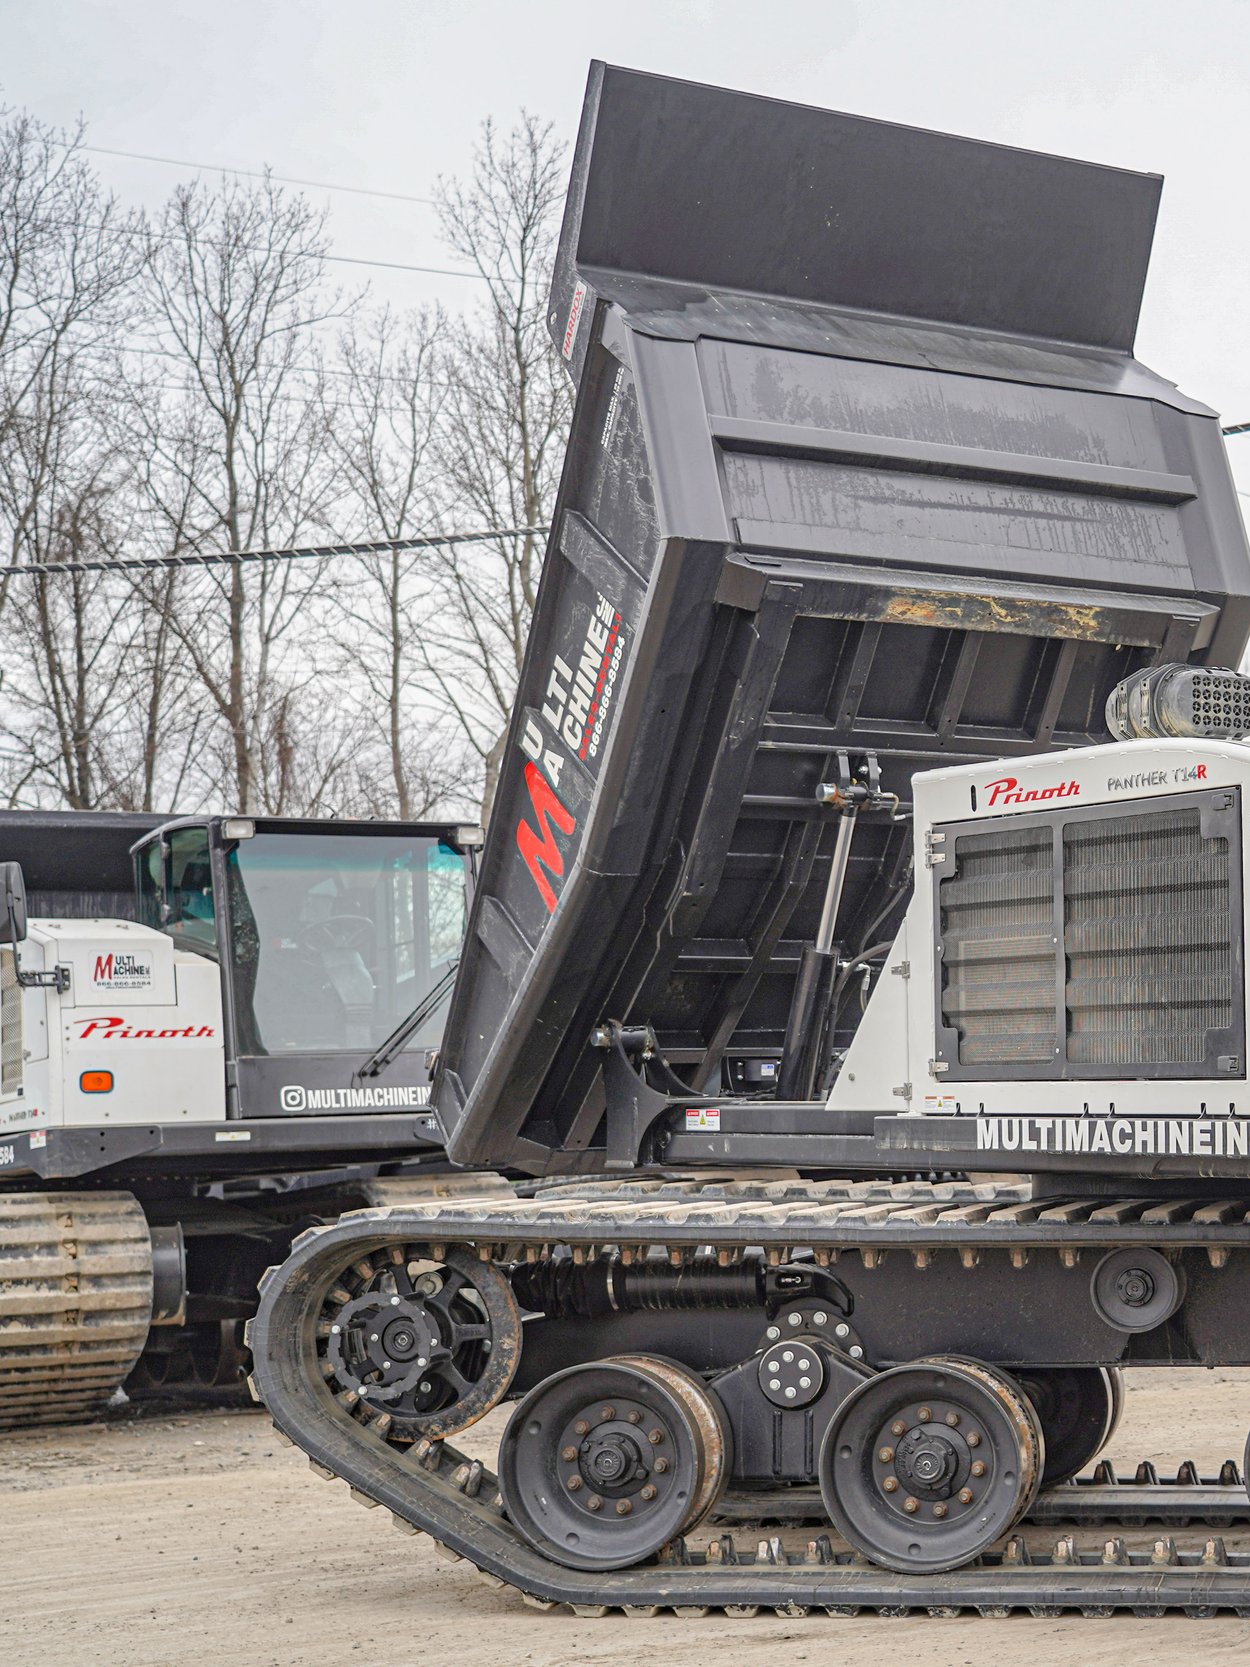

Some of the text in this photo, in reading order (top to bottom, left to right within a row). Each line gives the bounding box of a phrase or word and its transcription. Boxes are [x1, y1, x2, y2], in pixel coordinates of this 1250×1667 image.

[563, 288, 583, 355] HARDOX
[588, 635, 626, 758] 866-866-8584
[984, 777, 1080, 806] Prinoth
[1107, 764, 1207, 791] PANTHER T14R
[73, 1017, 215, 1039] Prinoth
[307, 1086, 433, 1109] MULTIMACHINEIN
